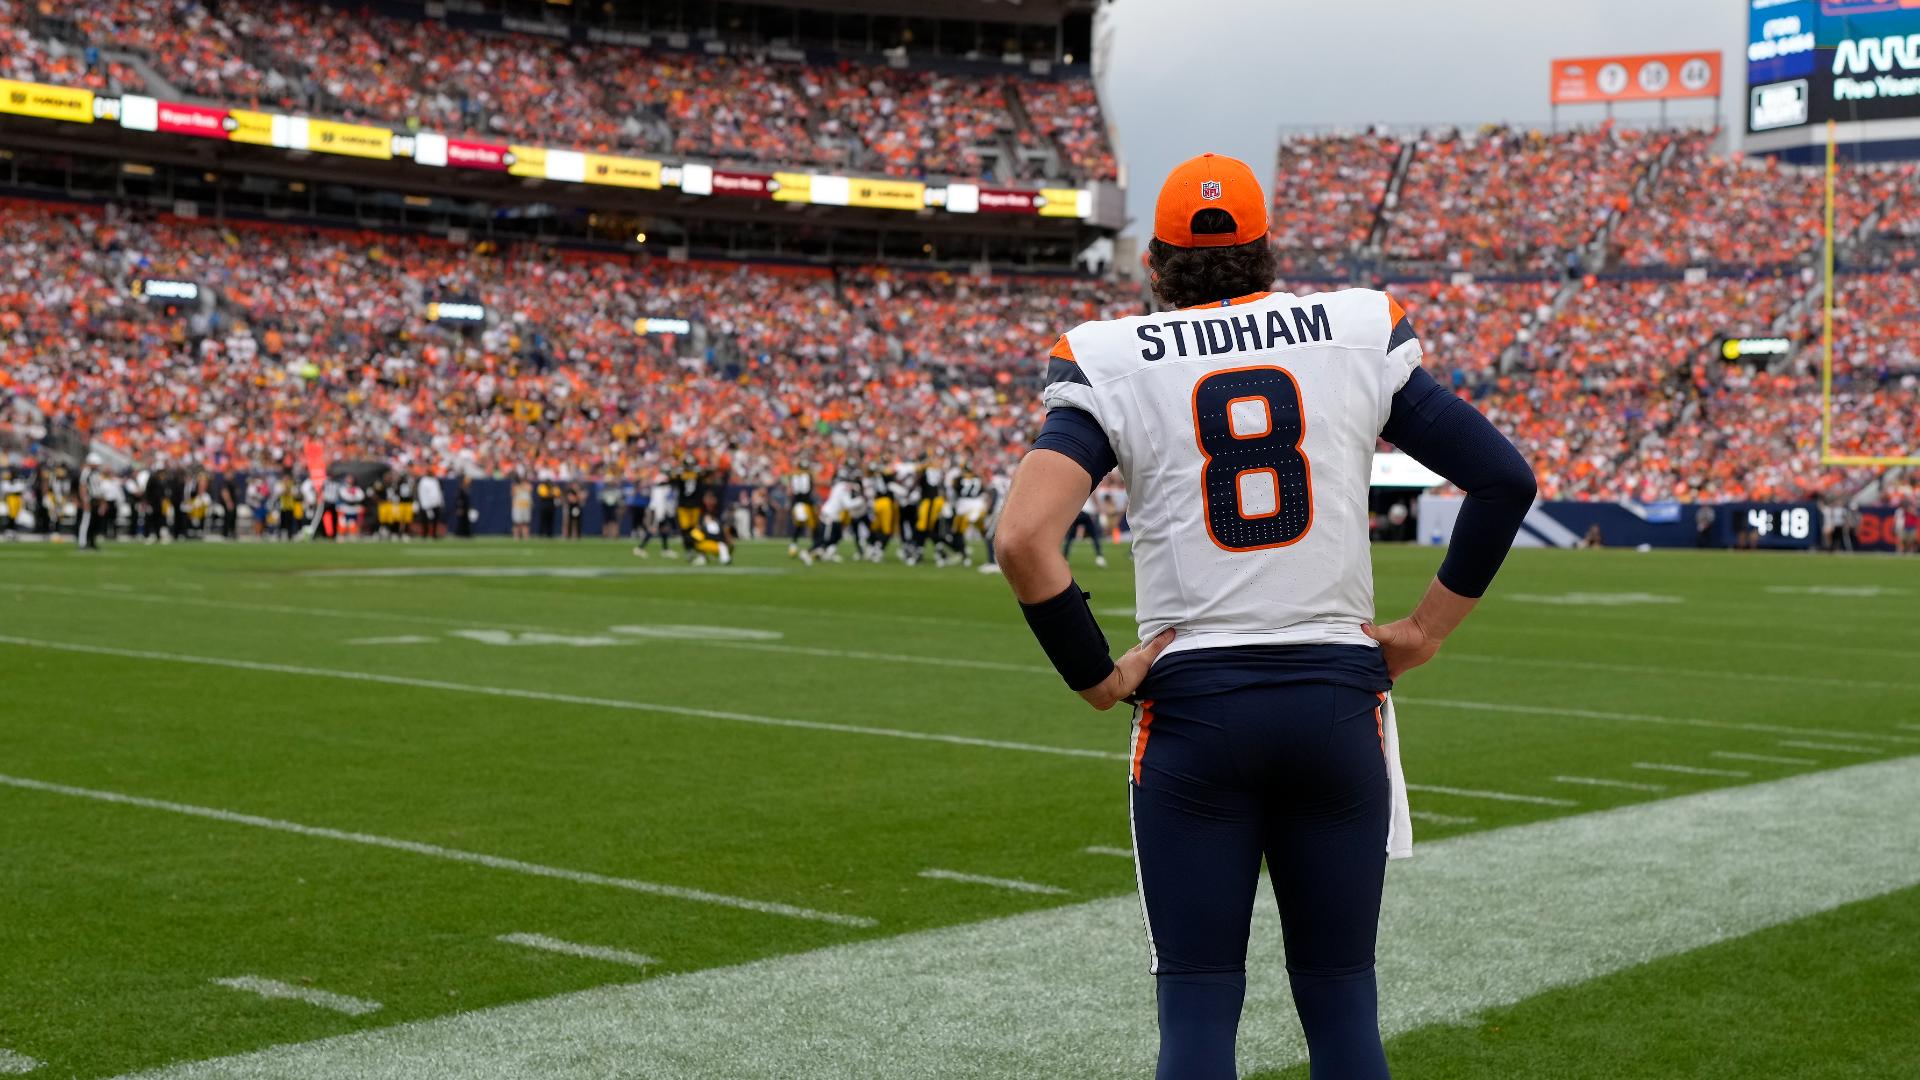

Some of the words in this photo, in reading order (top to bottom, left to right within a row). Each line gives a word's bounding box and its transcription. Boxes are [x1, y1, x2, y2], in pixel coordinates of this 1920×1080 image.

[1203, 187, 1219, 198] NFL
[1136, 303, 1333, 361] STIDHAM
[1191, 364, 1314, 552] 8
[1748, 507, 1809, 539] 4:18
